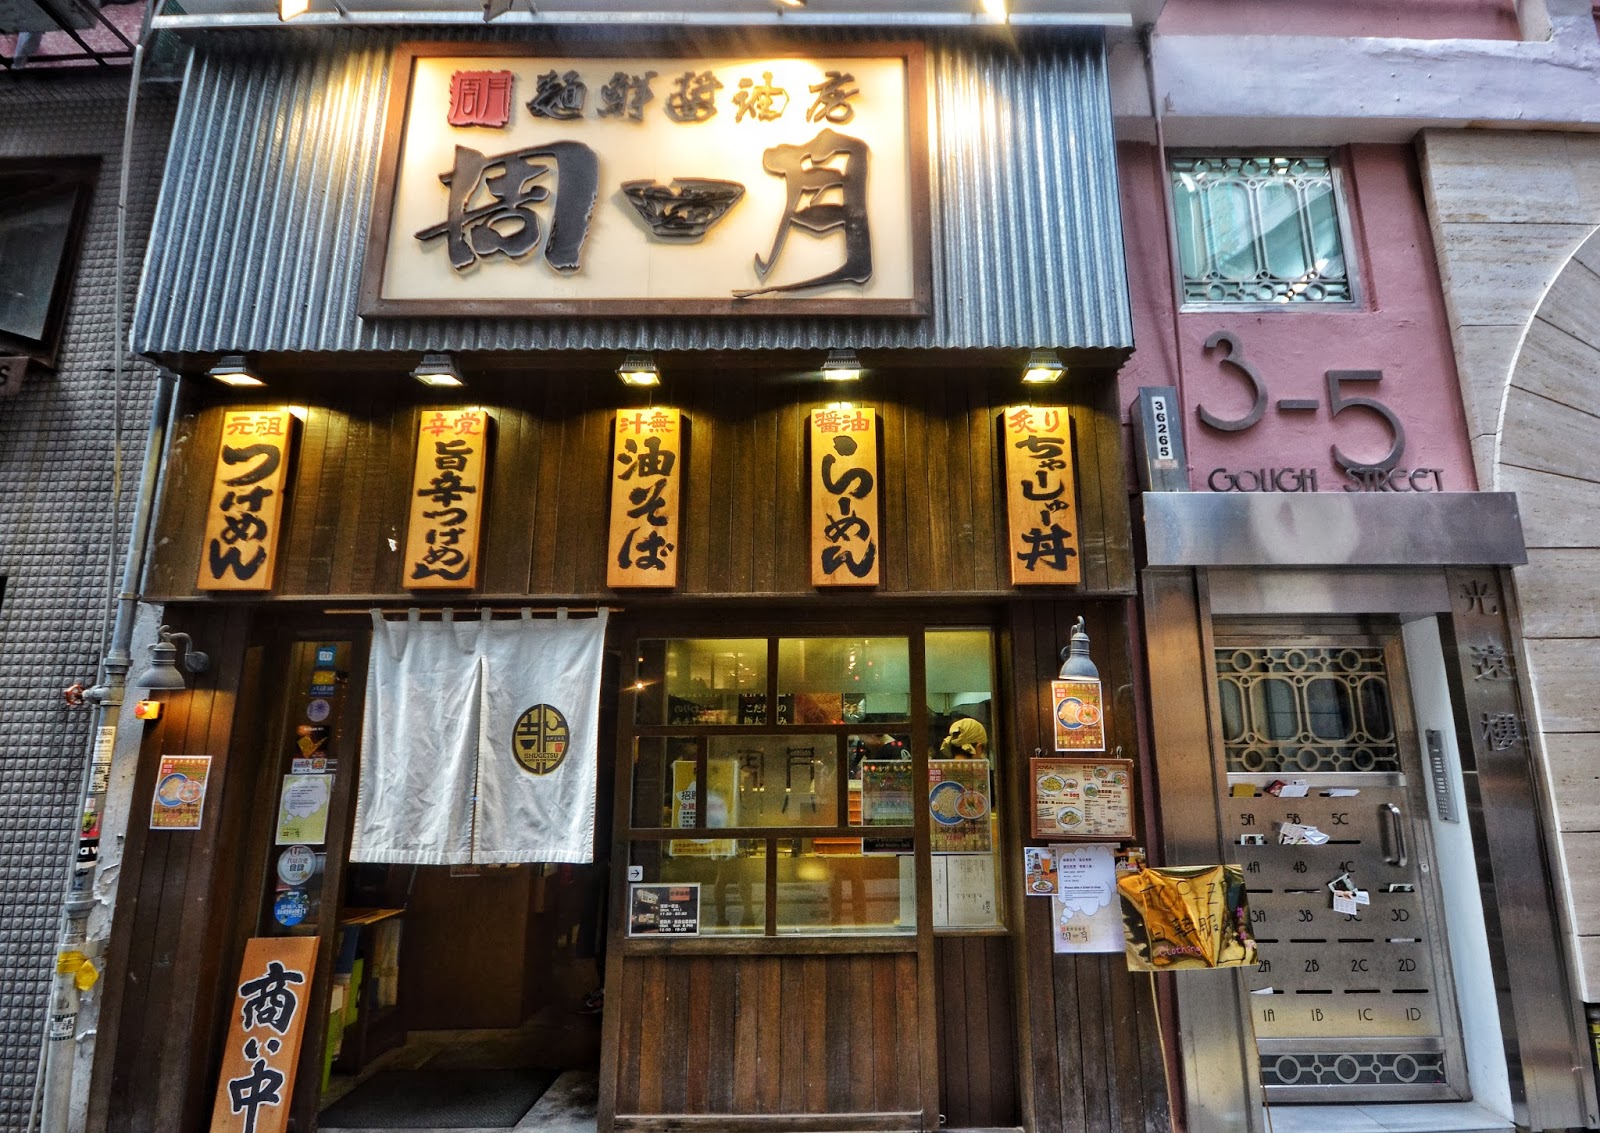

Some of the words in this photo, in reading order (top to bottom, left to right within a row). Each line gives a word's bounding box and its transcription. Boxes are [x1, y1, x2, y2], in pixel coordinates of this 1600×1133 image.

[1197, 331, 1405, 472] 3-5
[226, 415, 282, 437] 元祖
[421, 412, 482, 438] 辛党
[620, 413, 676, 435] 汁無
[1008, 408, 1061, 434] 炙り
[1154, 401, 1170, 457] 36265
[1208, 466, 1319, 493] GOUGH
[1343, 467, 1445, 493] STREET
[410, 438, 476, 582] 旨辛つけめん
[616, 435, 676, 572] 油そば
[820, 435, 876, 579] らーめん
[209, 444, 282, 582] つけめん
[1240, 813, 1255, 827] 5A
[1286, 813, 1301, 825] 5B
[1332, 813, 1349, 826] 5C
[1246, 861, 1261, 874] 4A
[1293, 861, 1307, 874] 4B
[1339, 861, 1356, 874] 4C
[1251, 910, 1266, 923] 3A
[1299, 910, 1314, 922] 3B
[1391, 909, 1409, 922] 3D
[1159, 944, 1203, 957] Clothing
[1258, 959, 1272, 973] 2A
[1305, 959, 1320, 972] 2B
[1351, 959, 1368, 972] 2C
[1398, 959, 1416, 972] 2D
[1264, 1009, 1275, 1022] 1A
[1312, 1009, 1324, 1022] 1B
[1358, 1008, 1373, 1021] 1C
[1406, 1008, 1421, 1021] 1D
[229, 959, 305, 1133] 商い中
